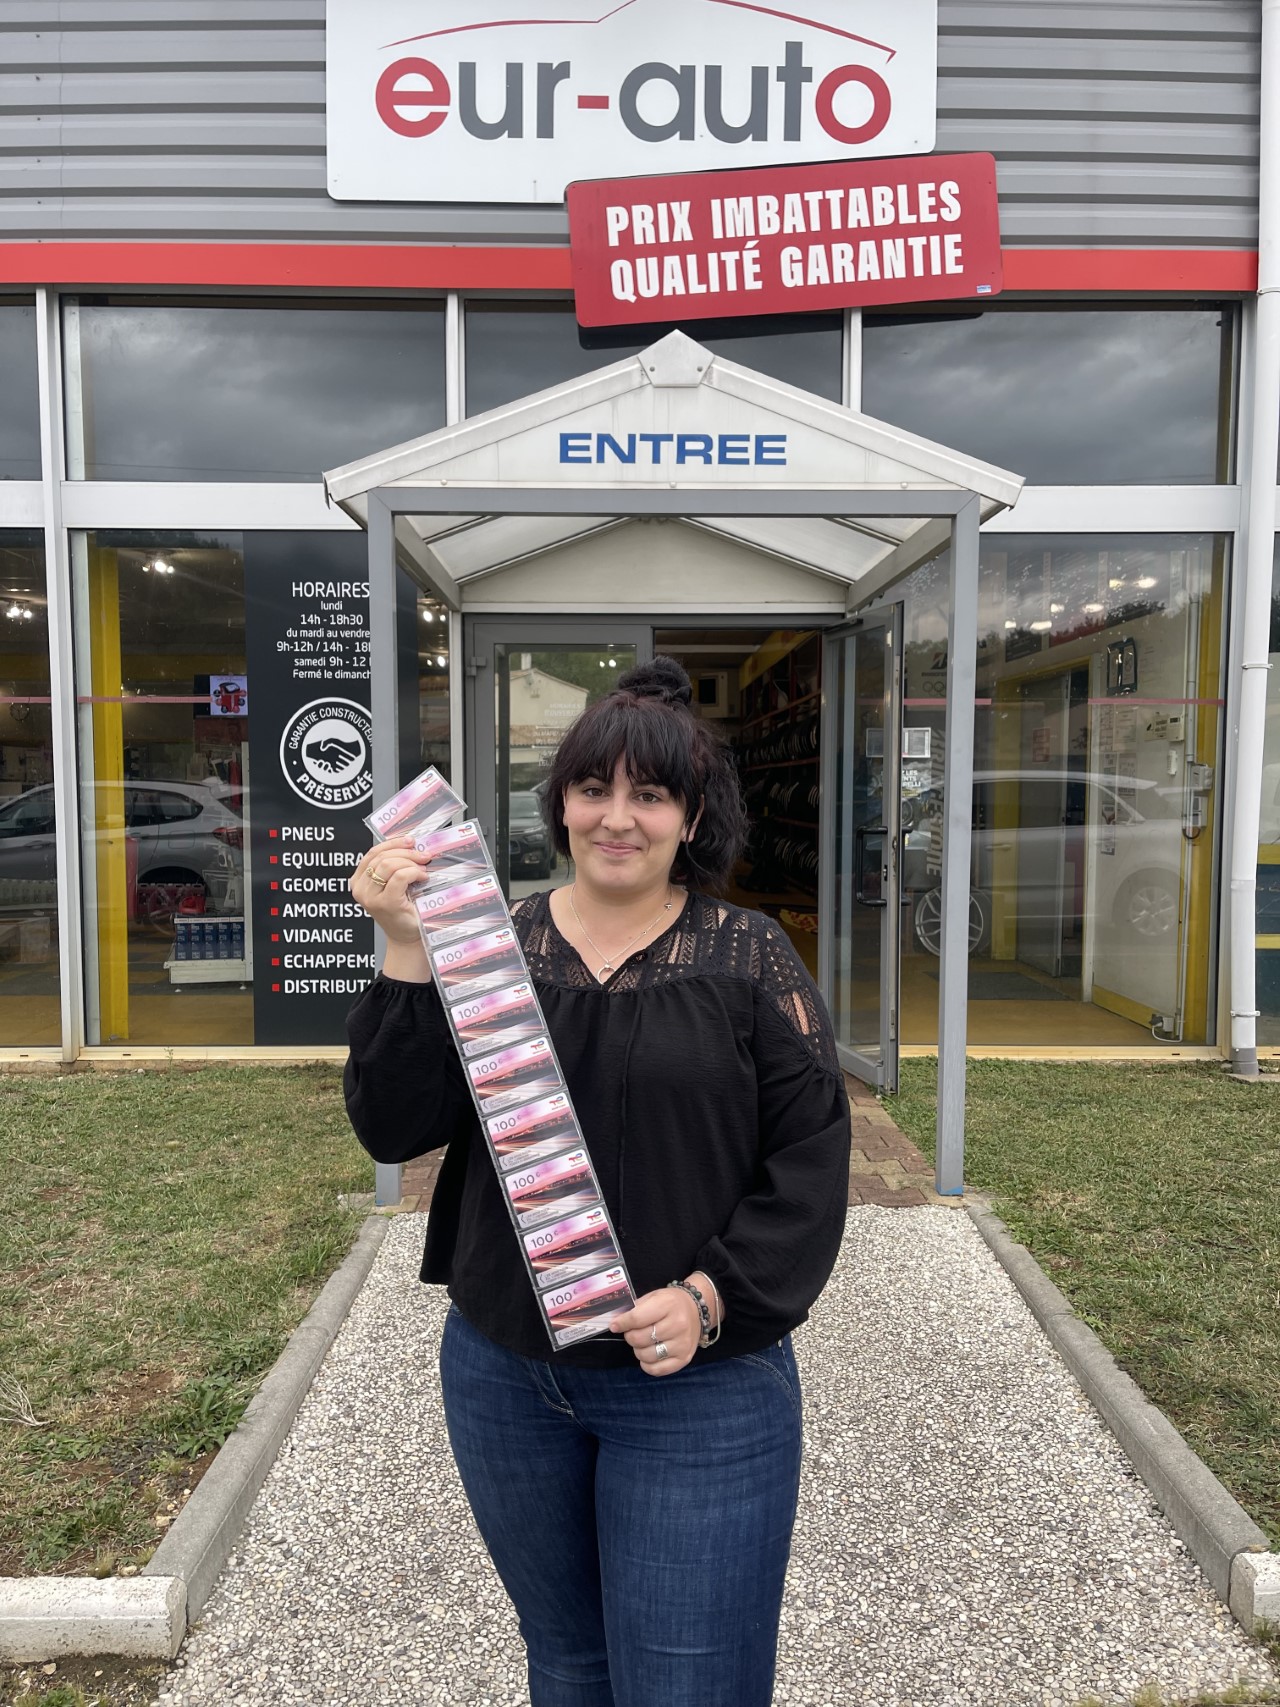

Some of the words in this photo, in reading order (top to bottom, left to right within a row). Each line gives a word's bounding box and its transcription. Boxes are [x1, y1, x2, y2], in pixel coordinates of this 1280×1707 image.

[375, 41, 892, 145] eur-auto
[606, 200, 693, 247] PRIX
[711, 180, 962, 239] IMBATTABLES
[610, 240, 763, 303] QUALITÉ
[780, 233, 964, 288] GARANTIE
[559, 432, 787, 465] ENTREE
[292, 581, 370, 598] HORAIRES
[320, 600, 343, 611] lundi
[300, 614, 321, 625] 14h
[329, 614, 364, 625] 18h30
[286, 627, 298, 638] du
[300, 627, 325, 638] mardi
[326, 630, 338, 638] au
[340, 628, 371, 638] vendre
[276, 641, 314, 652] 9h-12h
[323, 641, 343, 652] 14h
[294, 656, 326, 667] samedi
[329, 656, 343, 667] 9h
[352, 656, 366, 667] 12
[292, 668, 322, 679] Fermé
[324, 669, 333, 679] le
[288, 711, 319, 750] GARANTIE
[281, 826, 335, 841] PNEUS
[282, 852, 364, 869] EQUILIBRA
[282, 878, 351, 892] GEOMET
[423, 896, 445, 910] 100
[283, 928, 354, 943] VIDANGE
[441, 950, 463, 964] 100
[284, 979, 371, 994] DISTRIBUT
[458, 1005, 480, 1020] 100
[476, 1061, 498, 1076] 100
[494, 1117, 516, 1132] 100
[513, 1174, 535, 1190] 100
[531, 1233, 553, 1248] 100
[550, 1291, 573, 1307] 100
